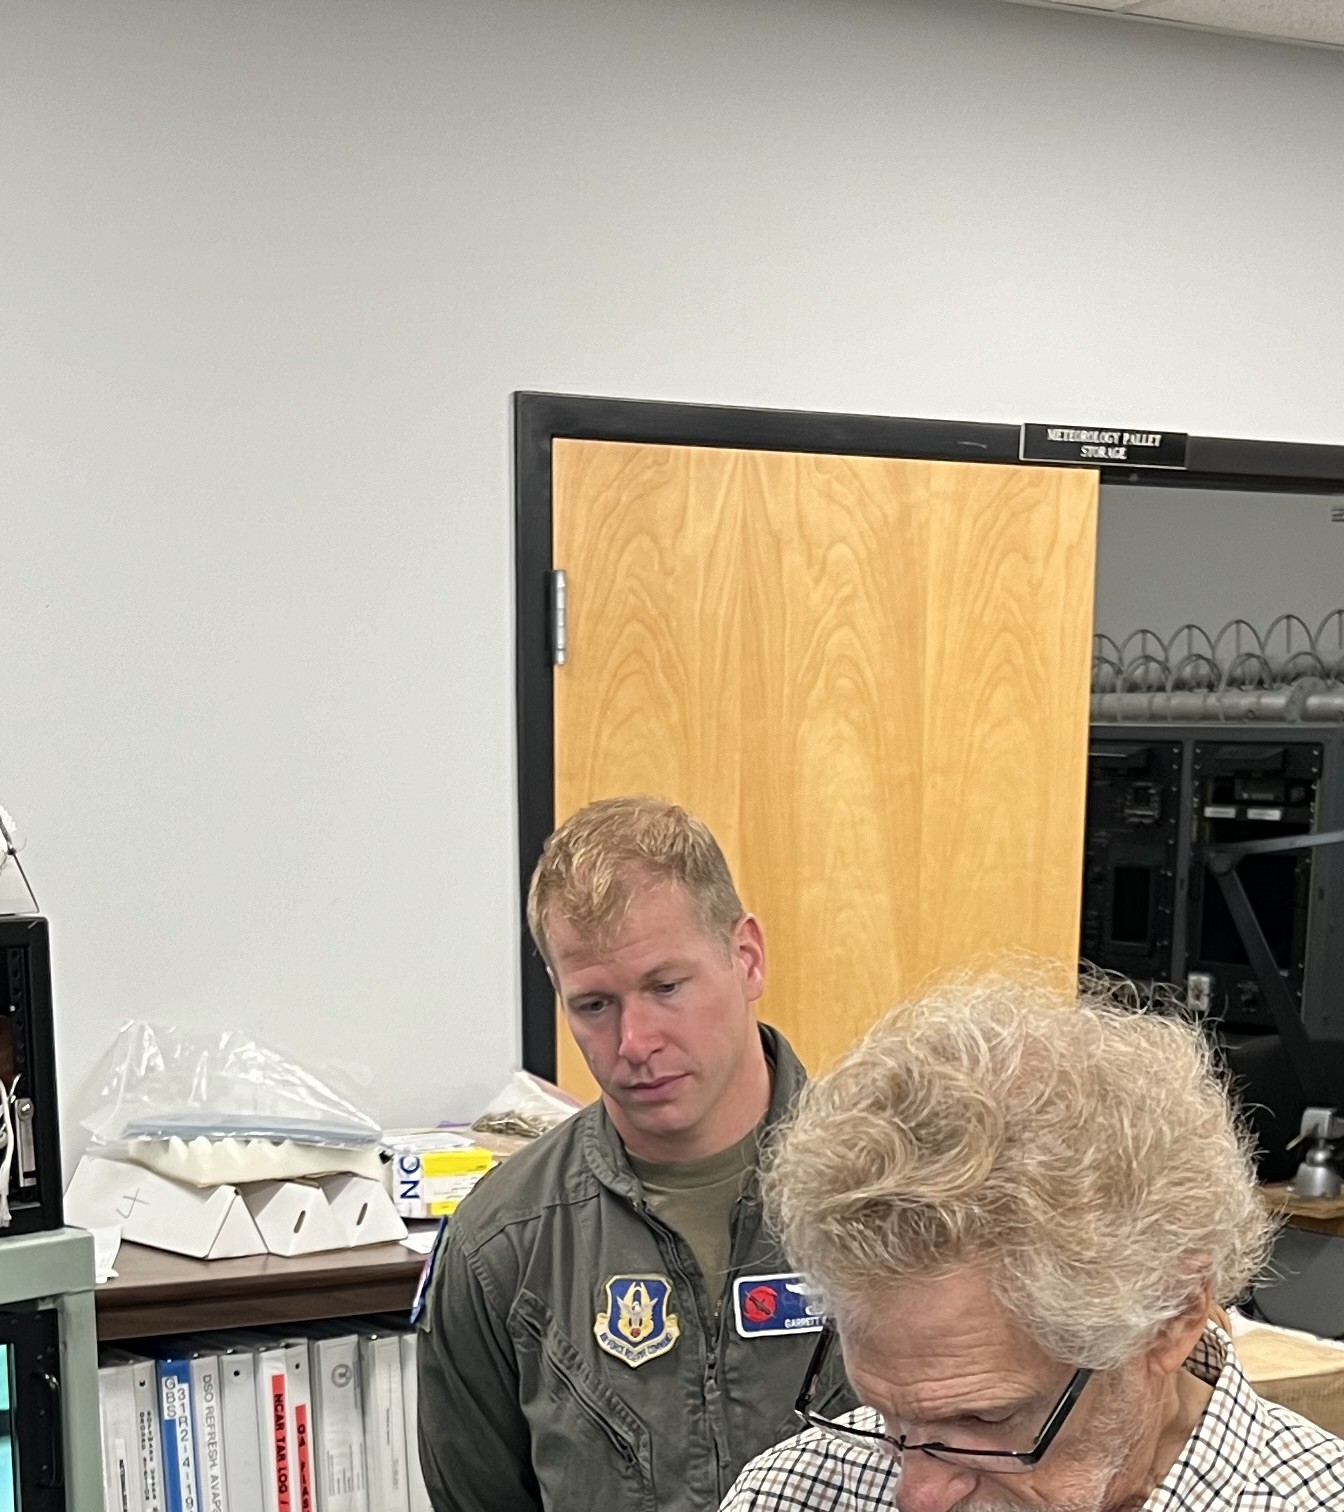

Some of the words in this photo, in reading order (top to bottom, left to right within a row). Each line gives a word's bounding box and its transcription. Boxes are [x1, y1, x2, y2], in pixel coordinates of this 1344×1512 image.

[1122, 433, 1162, 447] PALLET
[784, 1317, 820, 1329] GARRETT
[164, 1377, 177, 1418] GBS
[202, 1374, 214, 1403] DSO
[274, 1393, 284, 1433] NCAR
[278, 1469, 288, 1494] LOG
